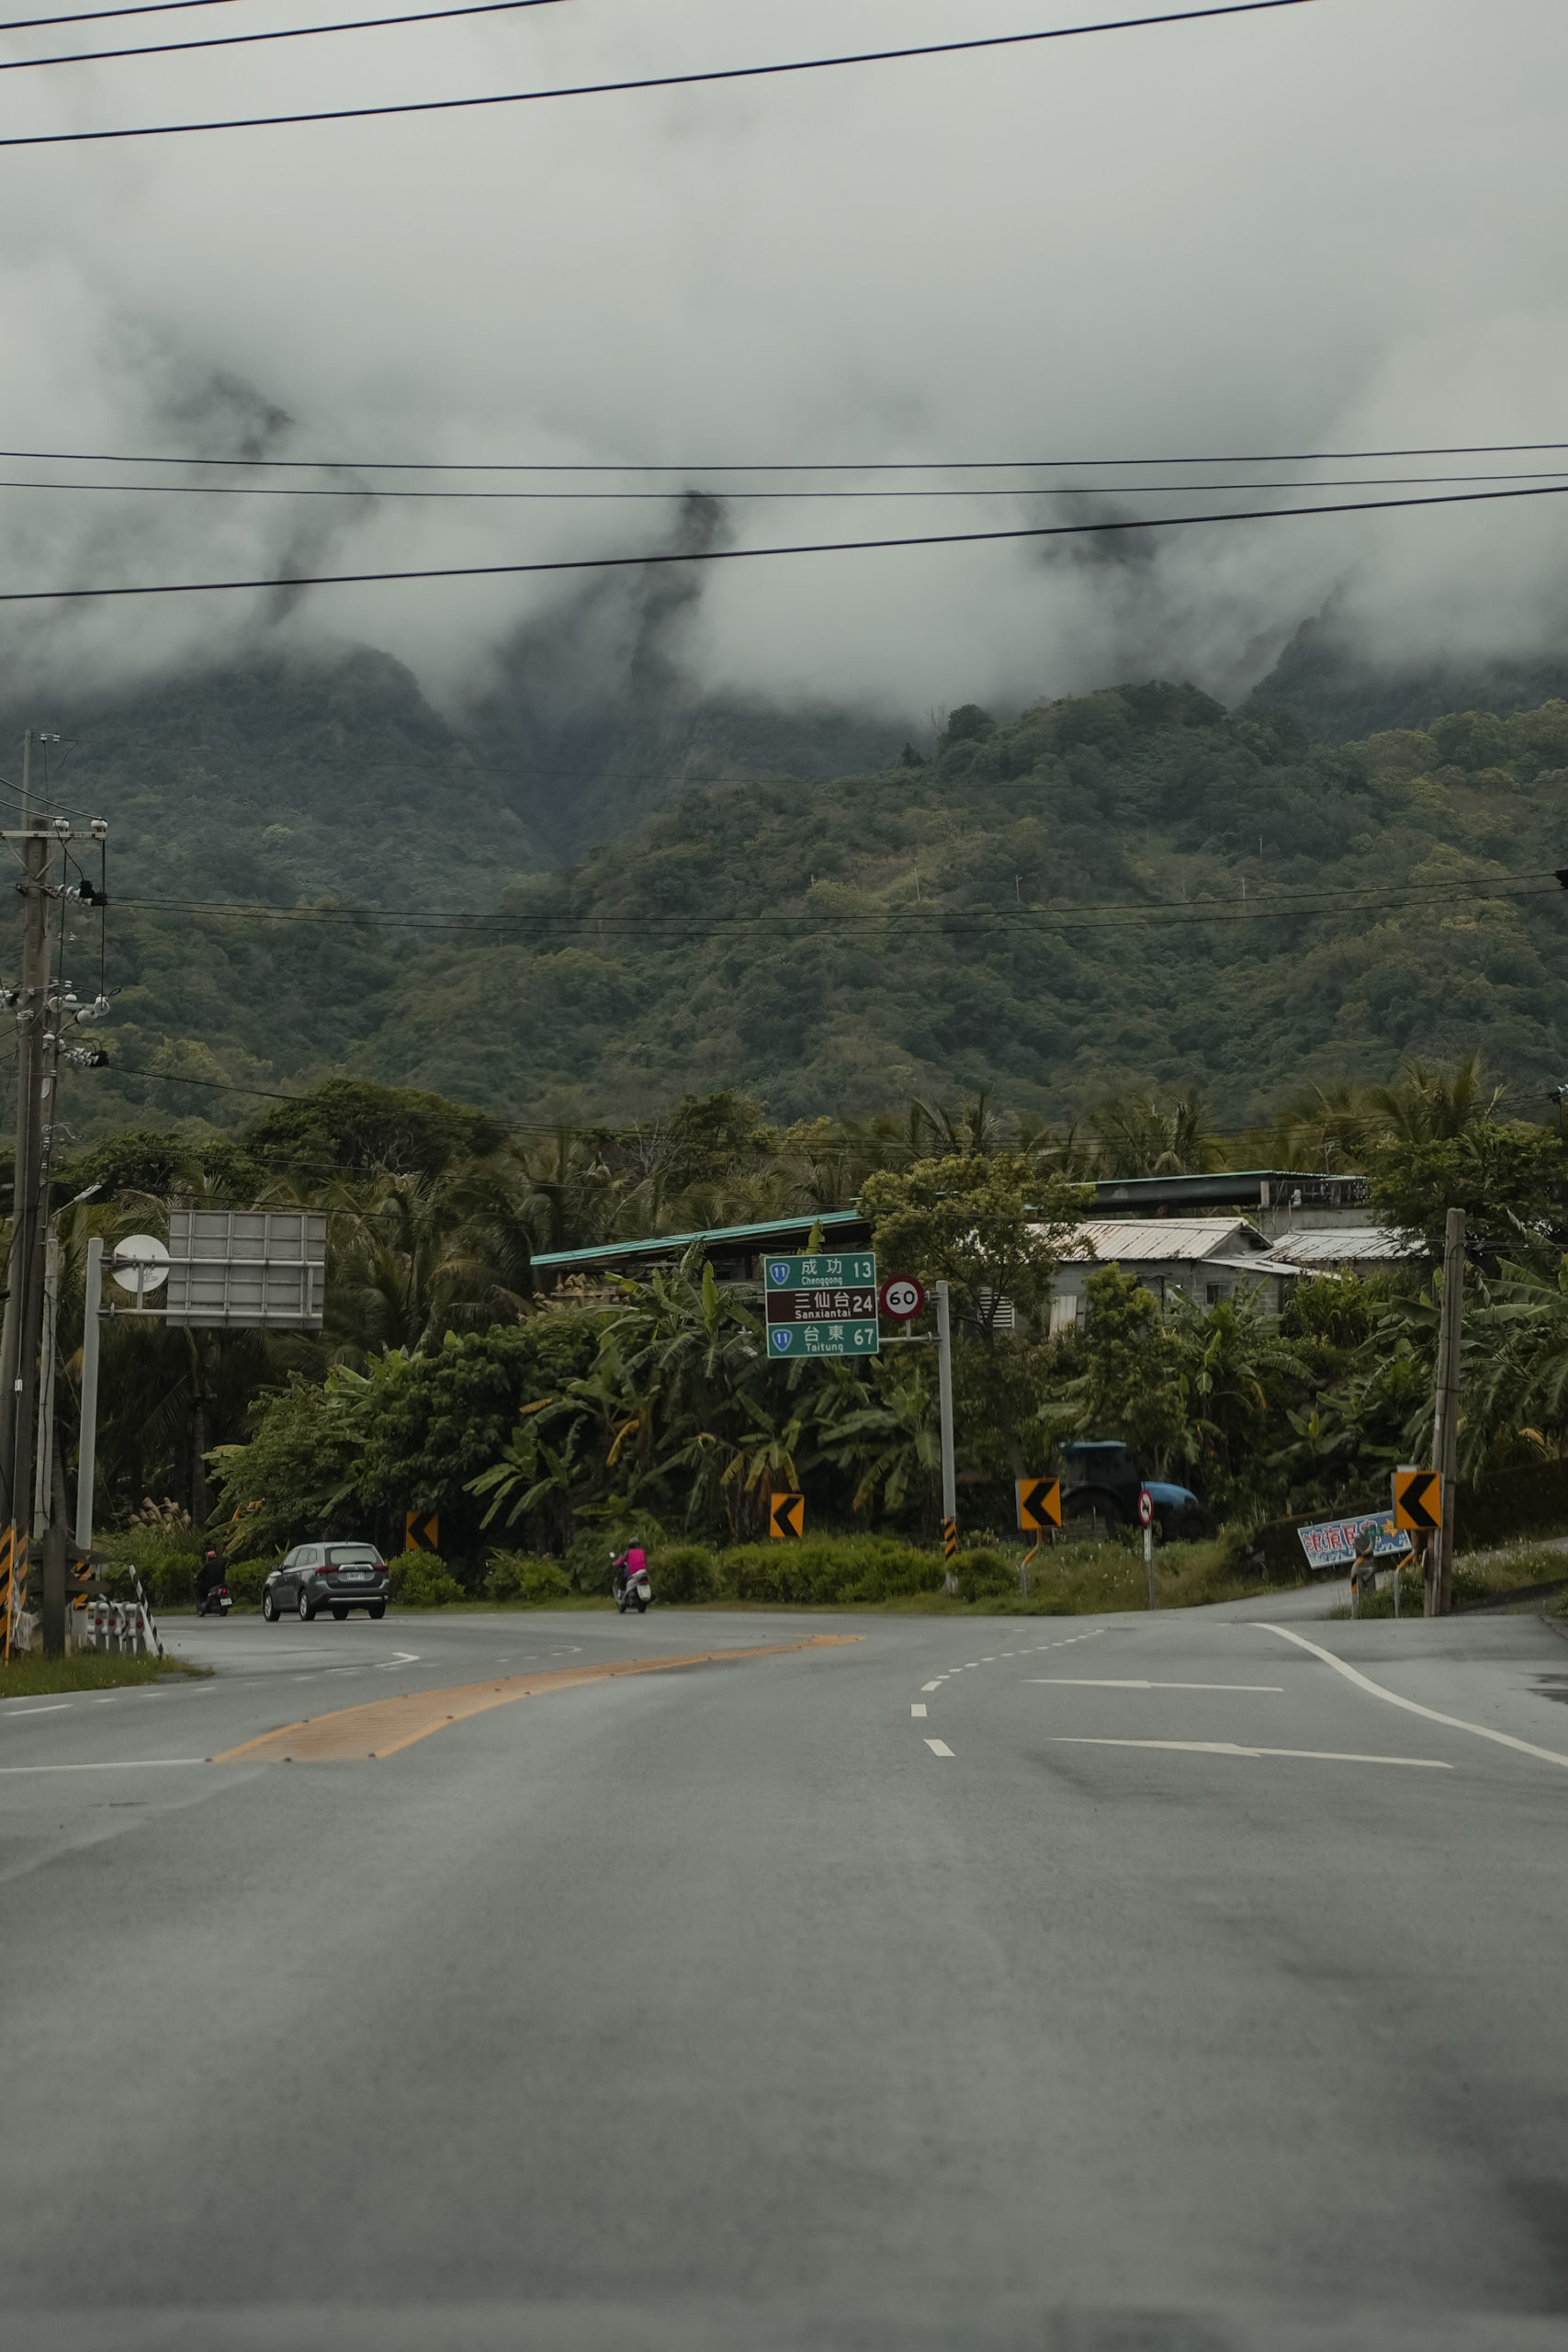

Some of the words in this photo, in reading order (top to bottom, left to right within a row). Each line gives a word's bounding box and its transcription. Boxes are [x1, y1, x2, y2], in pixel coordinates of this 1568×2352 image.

[773, 1267, 785, 1277] 11
[801, 1258, 842, 1275] 成功
[853, 1261, 872, 1278] 13
[801, 1275, 843, 1286] Chenggong
[795, 1291, 850, 1308] 三仙台
[852, 1295, 873, 1312] 24
[889, 1290, 915, 1306] 60
[795, 1307, 852, 1319] Sanxiantai
[776, 1333, 788, 1344] 11
[804, 1325, 844, 1342] 台東
[853, 1329, 874, 1345] 67
[806, 1342, 844, 1353] Taitung
